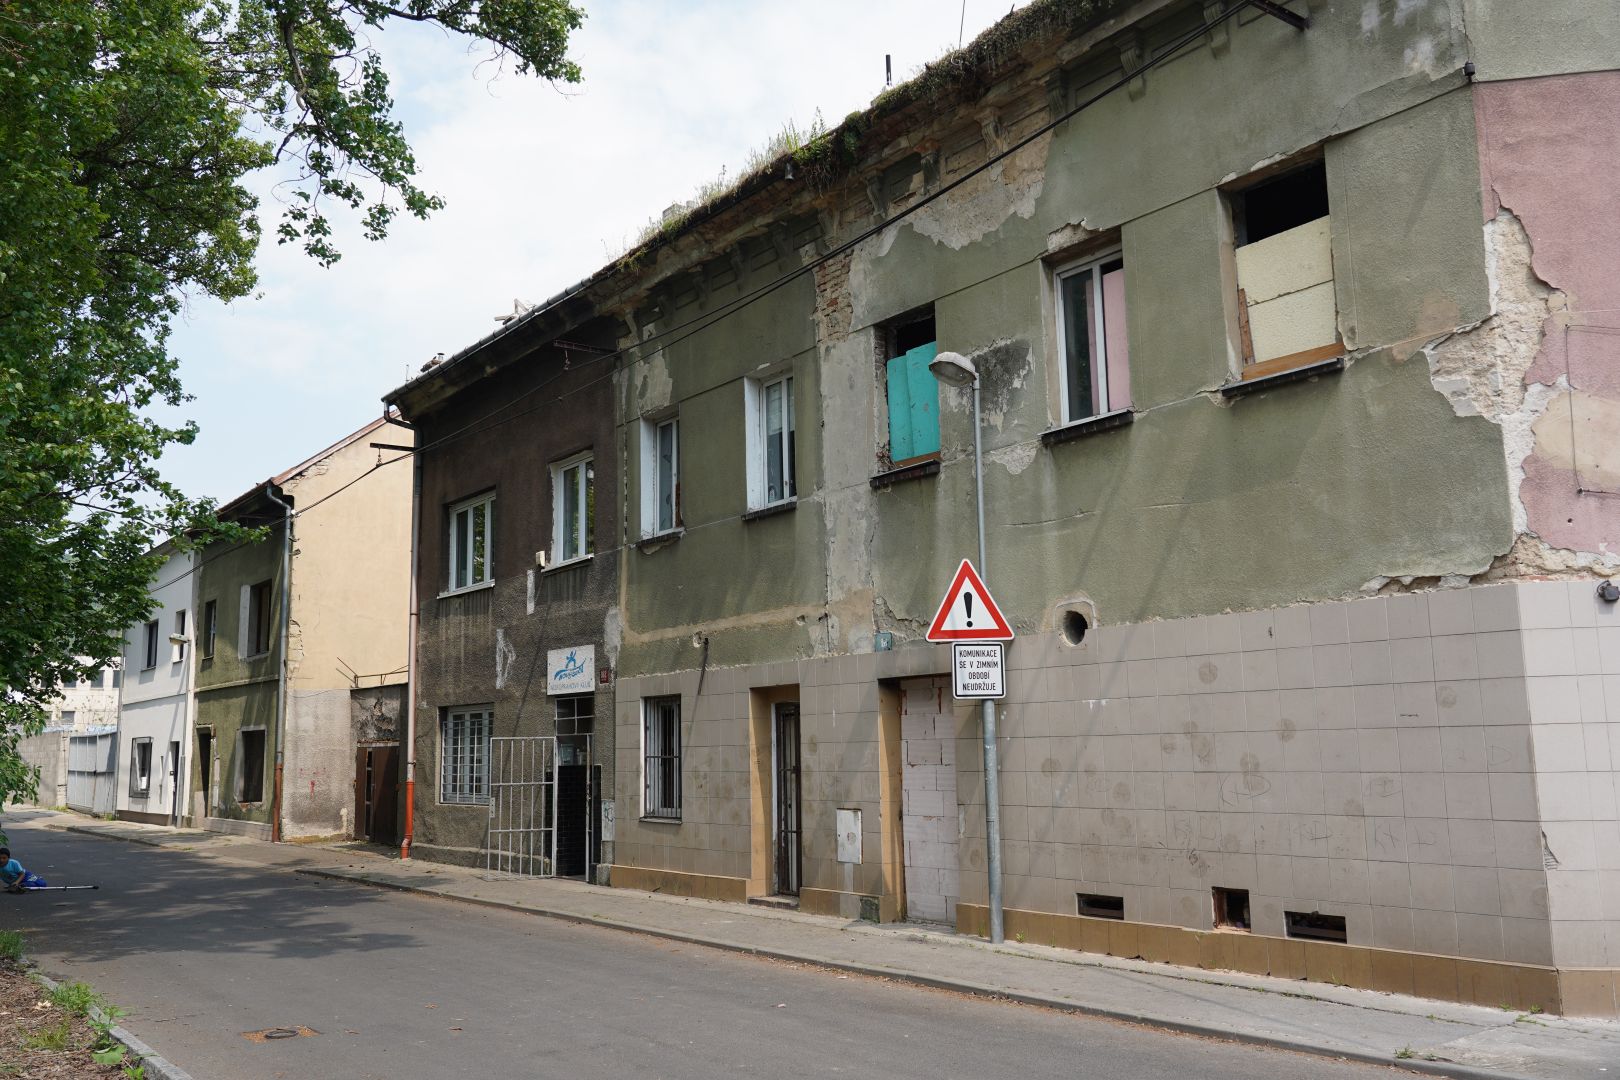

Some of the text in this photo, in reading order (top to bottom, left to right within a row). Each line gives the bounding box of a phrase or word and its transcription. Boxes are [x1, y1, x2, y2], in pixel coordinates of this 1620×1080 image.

[959, 650, 997, 658] KOMUNIKACE
[959, 659, 999, 669] SE V ZIMNÍM
[968, 671, 990, 680] OBDOBÍ
[962, 681, 996, 691] NEUDRŽUJE
